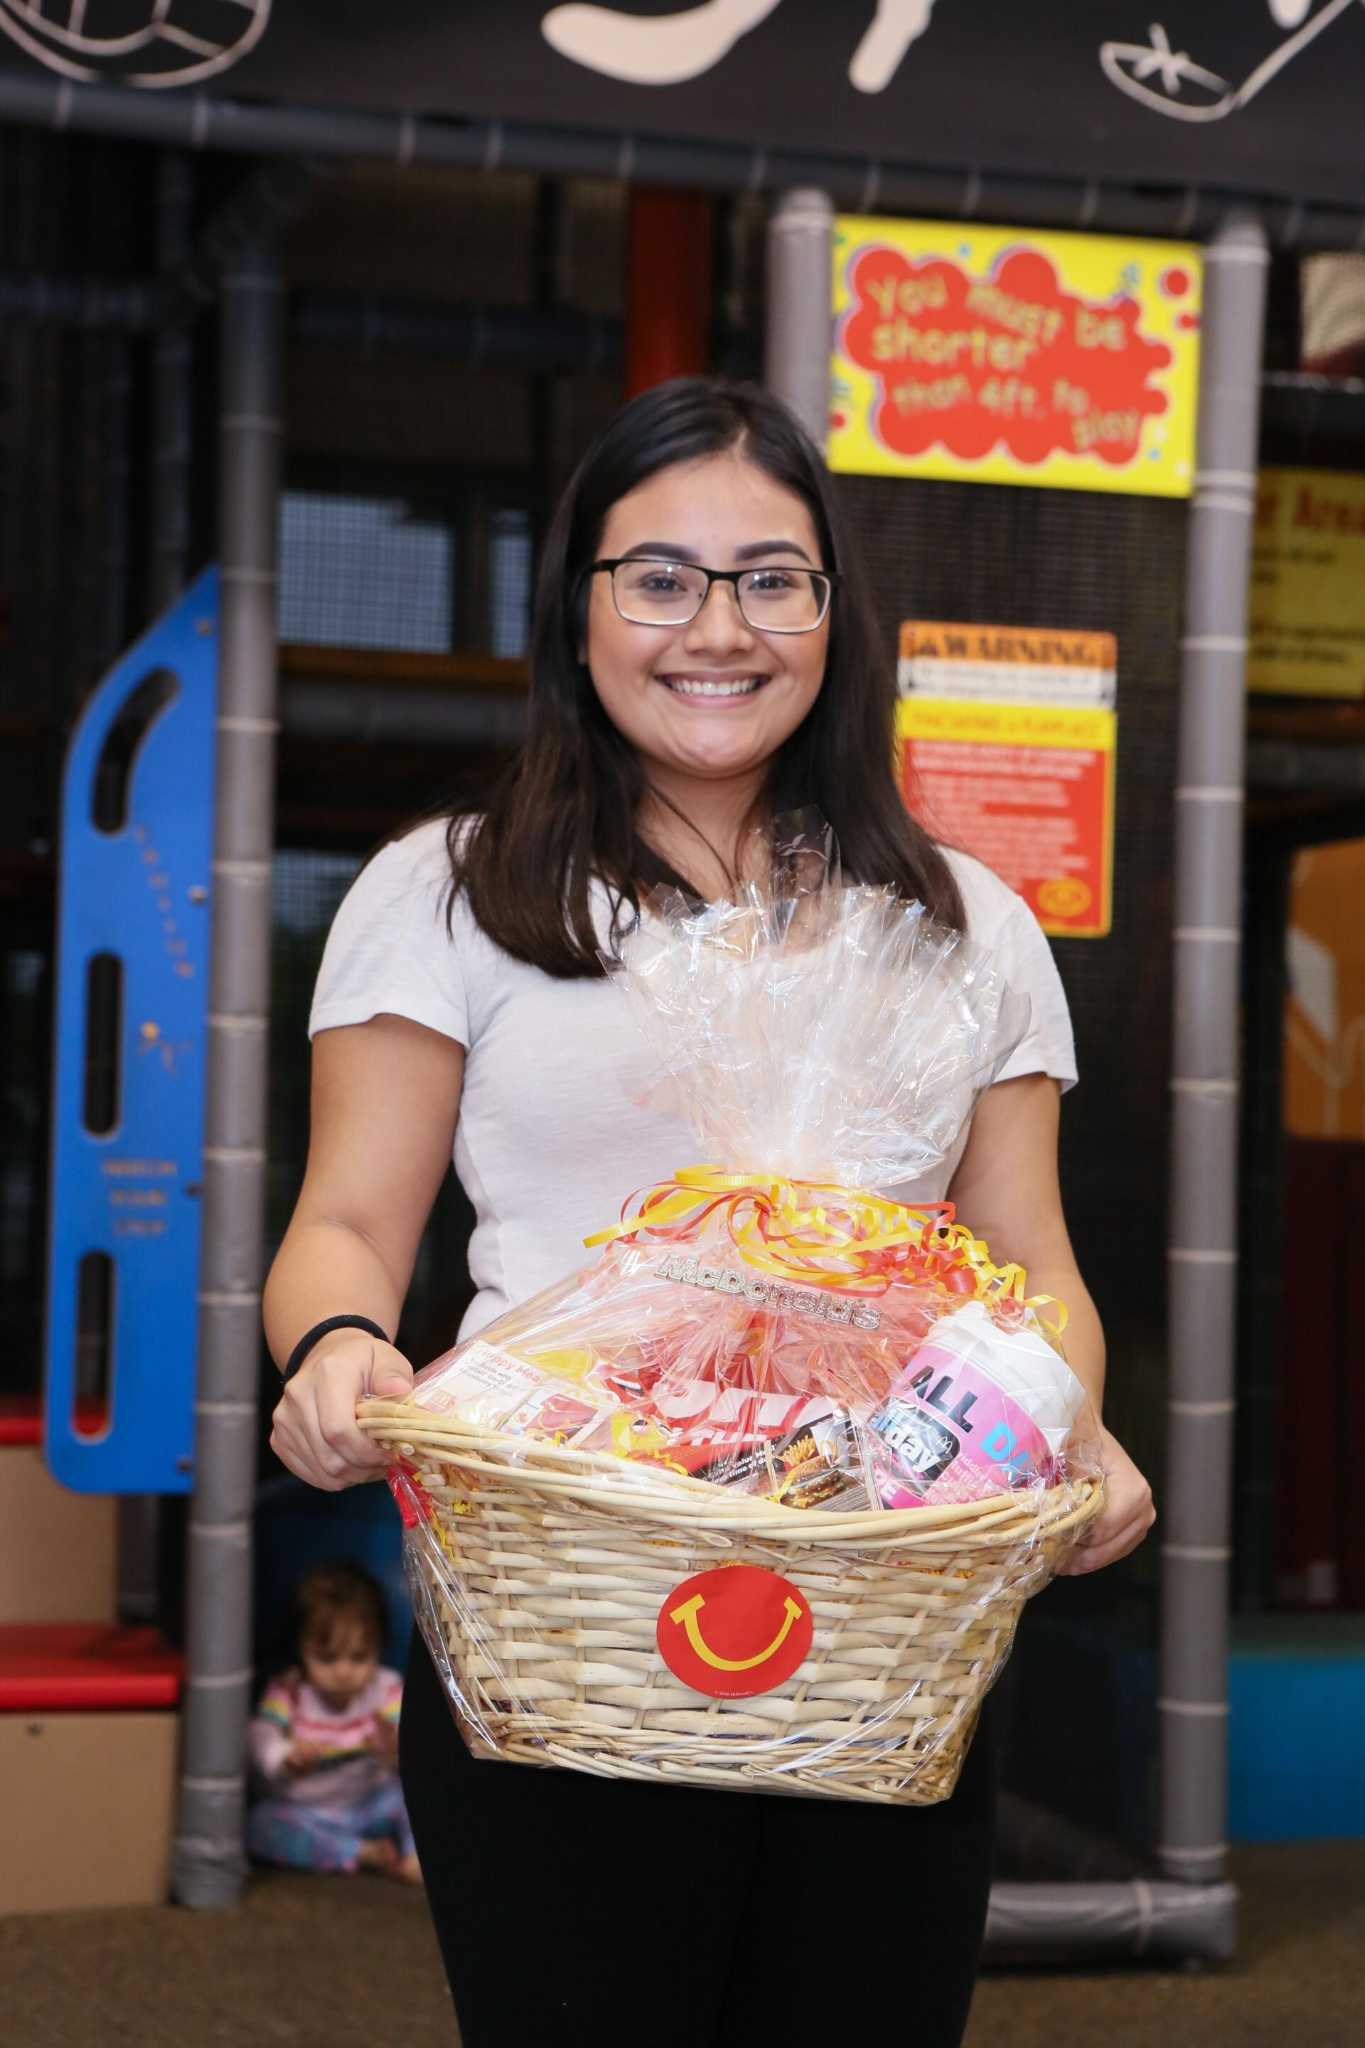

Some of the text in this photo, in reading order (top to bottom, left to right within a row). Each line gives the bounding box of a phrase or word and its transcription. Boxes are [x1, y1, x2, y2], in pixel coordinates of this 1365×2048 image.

[965, 282, 1062, 347] must
[1074, 303, 1127, 350] be
[872, 318, 1038, 369] shorter
[892, 374, 972, 416] than
[1053, 377, 1089, 416] to
[942, 634, 1098, 668] WARNING
[911, 1365, 978, 1433] ALL
